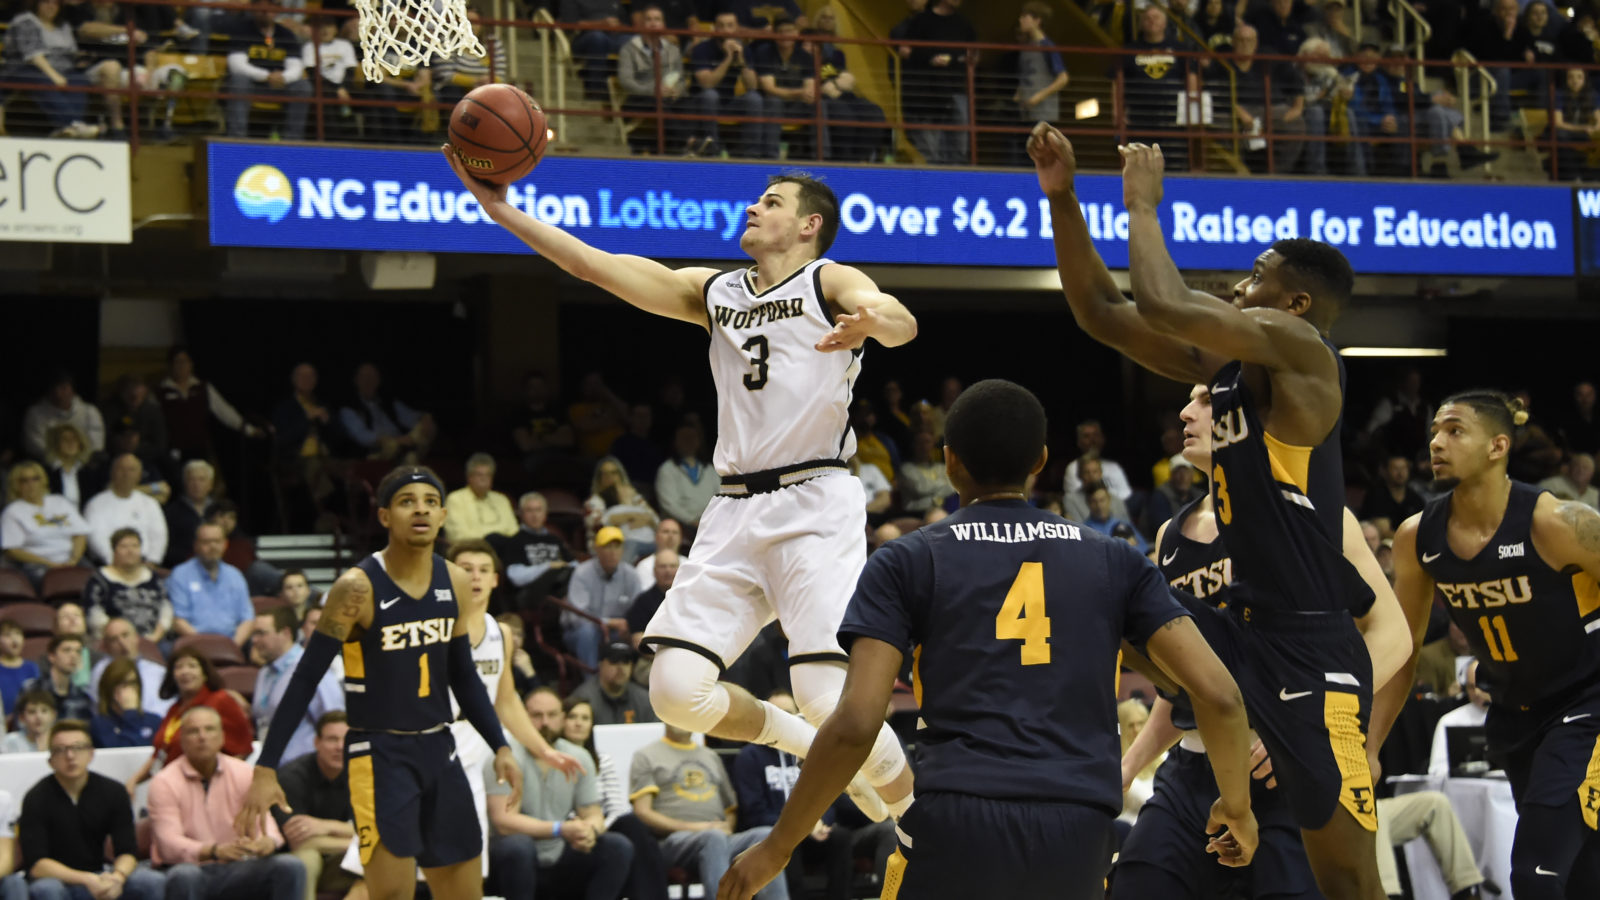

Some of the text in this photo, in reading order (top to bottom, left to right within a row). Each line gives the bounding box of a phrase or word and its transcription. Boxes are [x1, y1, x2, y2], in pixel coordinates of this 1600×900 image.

[0, 150, 105, 214] rc
[298, 178, 366, 220] NC
[373, 180, 592, 227] Eduction
[597, 188, 748, 242] Lottery
[841, 193, 941, 236] Over
[953, 196, 1028, 239] $6.2
[1173, 201, 1299, 243] Raised
[1311, 208, 1363, 246] for
[1374, 206, 1557, 250] Education
[714, 297, 804, 330] WOFFORD
[741, 334, 769, 391] 3
[950, 521, 1082, 543] WILLIAMSON
[1498, 542, 1525, 559] SOCON
[995, 561, 1051, 665] 4
[1437, 575, 1533, 609] ETSU
[381, 617, 456, 651] ETSU
[1478, 615, 1519, 662] 11
[418, 652, 431, 698] 1
